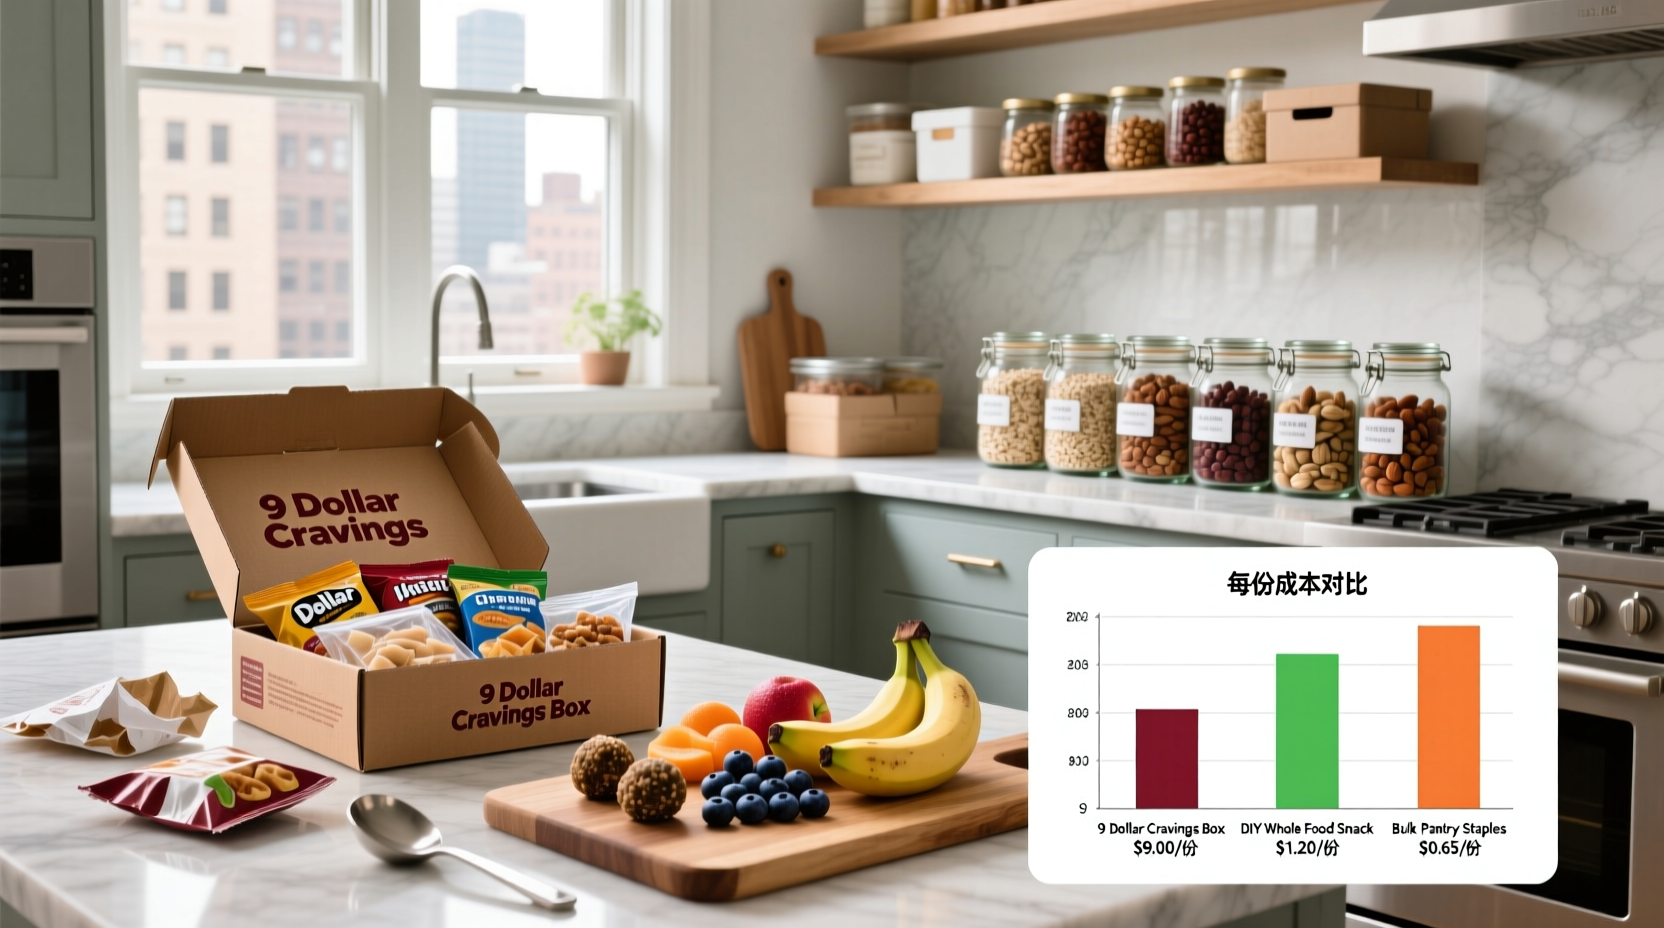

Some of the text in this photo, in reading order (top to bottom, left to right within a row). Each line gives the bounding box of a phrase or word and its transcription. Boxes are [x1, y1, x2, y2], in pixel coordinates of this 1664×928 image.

[258, 488, 400, 521] 9 Dollar
[263, 515, 429, 549] Cravings
[293, 588, 355, 625] Dollar
[479, 677, 564, 705] 9 Dollar
[450, 697, 592, 732] Cravings Box
